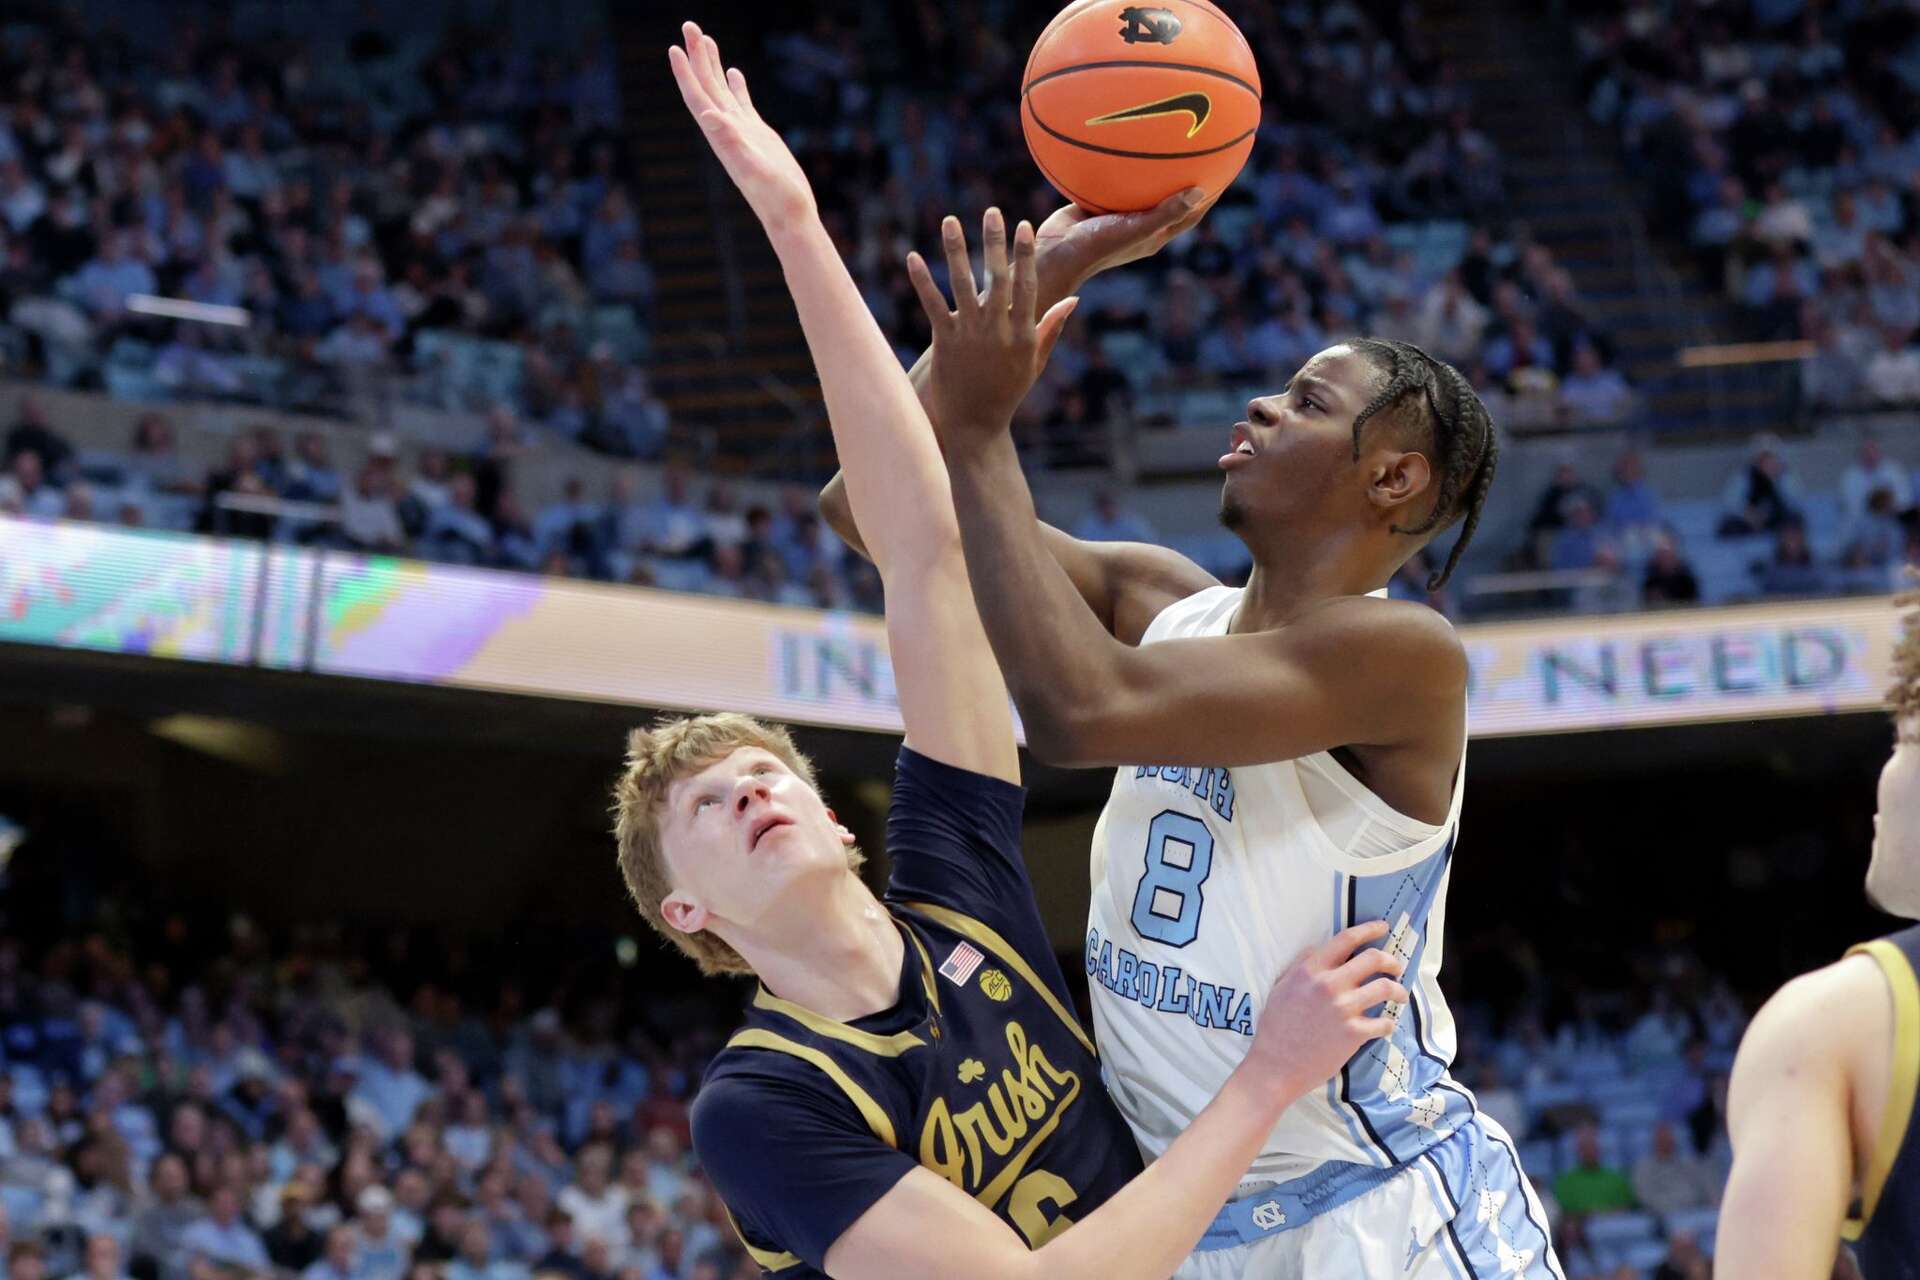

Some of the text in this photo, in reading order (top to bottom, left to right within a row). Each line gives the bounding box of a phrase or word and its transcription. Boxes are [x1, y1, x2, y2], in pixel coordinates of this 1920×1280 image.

[1542, 628, 1847, 704] NEED
[1131, 808, 1214, 948] 8
[1085, 927, 1254, 1036] CAROLINA
[919, 1020, 1081, 1190] Irish
